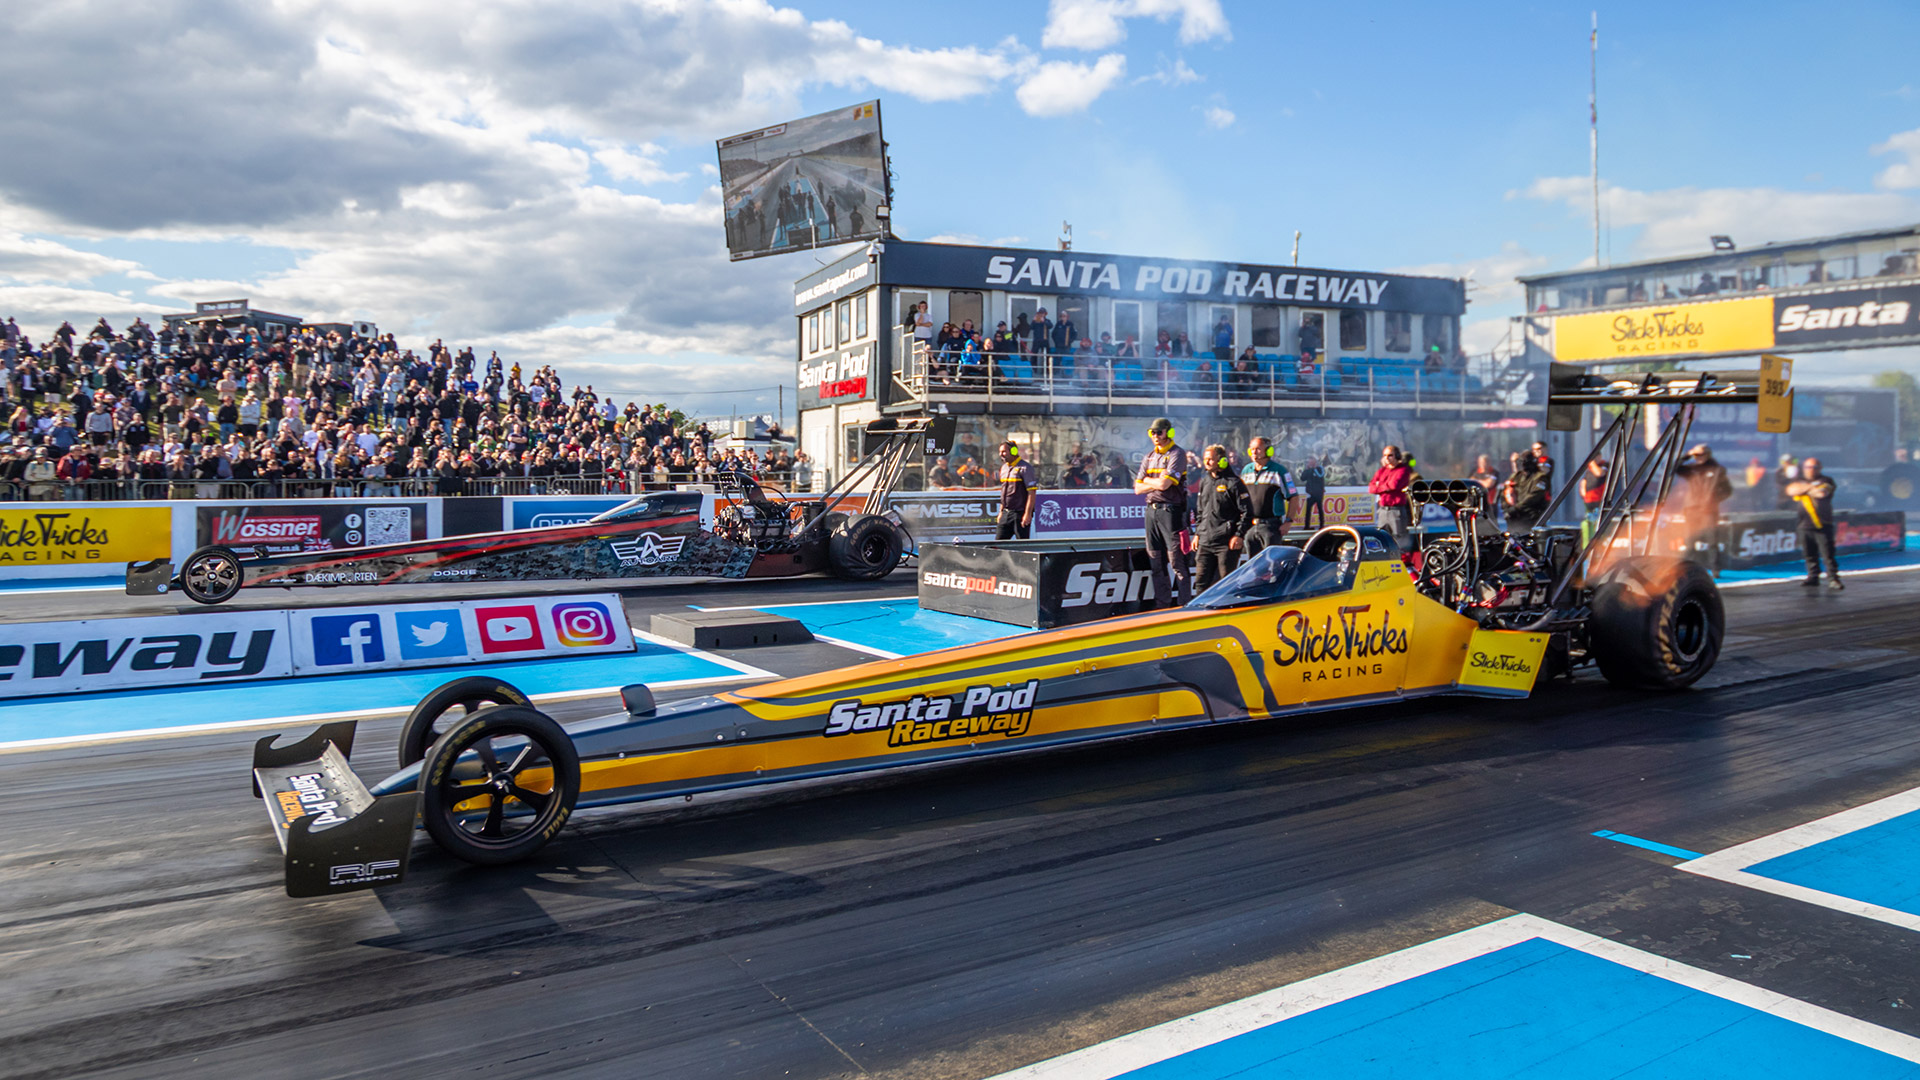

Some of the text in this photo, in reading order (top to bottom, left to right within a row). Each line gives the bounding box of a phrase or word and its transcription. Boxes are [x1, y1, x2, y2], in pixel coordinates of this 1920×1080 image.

[985, 255, 1390, 305] SANTA POD RACEWAY
[1777, 301, 1911, 332] Santa
[1617, 339, 1699, 352] RACING
[798, 346, 870, 389] Santa Pod
[818, 376, 868, 399] Raceway
[892, 503, 983, 519] NEMESIS
[1066, 506, 1118, 520] KESTREL
[1739, 528, 1797, 557] Santa
[0, 550, 100, 561] ACING
[620, 554, 680, 567] AUTOART
[433, 569, 477, 577] DODGE
[923, 571, 1033, 599] santapod.com
[1302, 663, 1383, 682] RACING
[825, 681, 1039, 735] Santa Pod
[890, 711, 1031, 745] Raceway
[289, 773, 326, 803] Santa
[542, 806, 569, 840] EAGLE
[329, 873, 399, 886] MOTORSPORT
